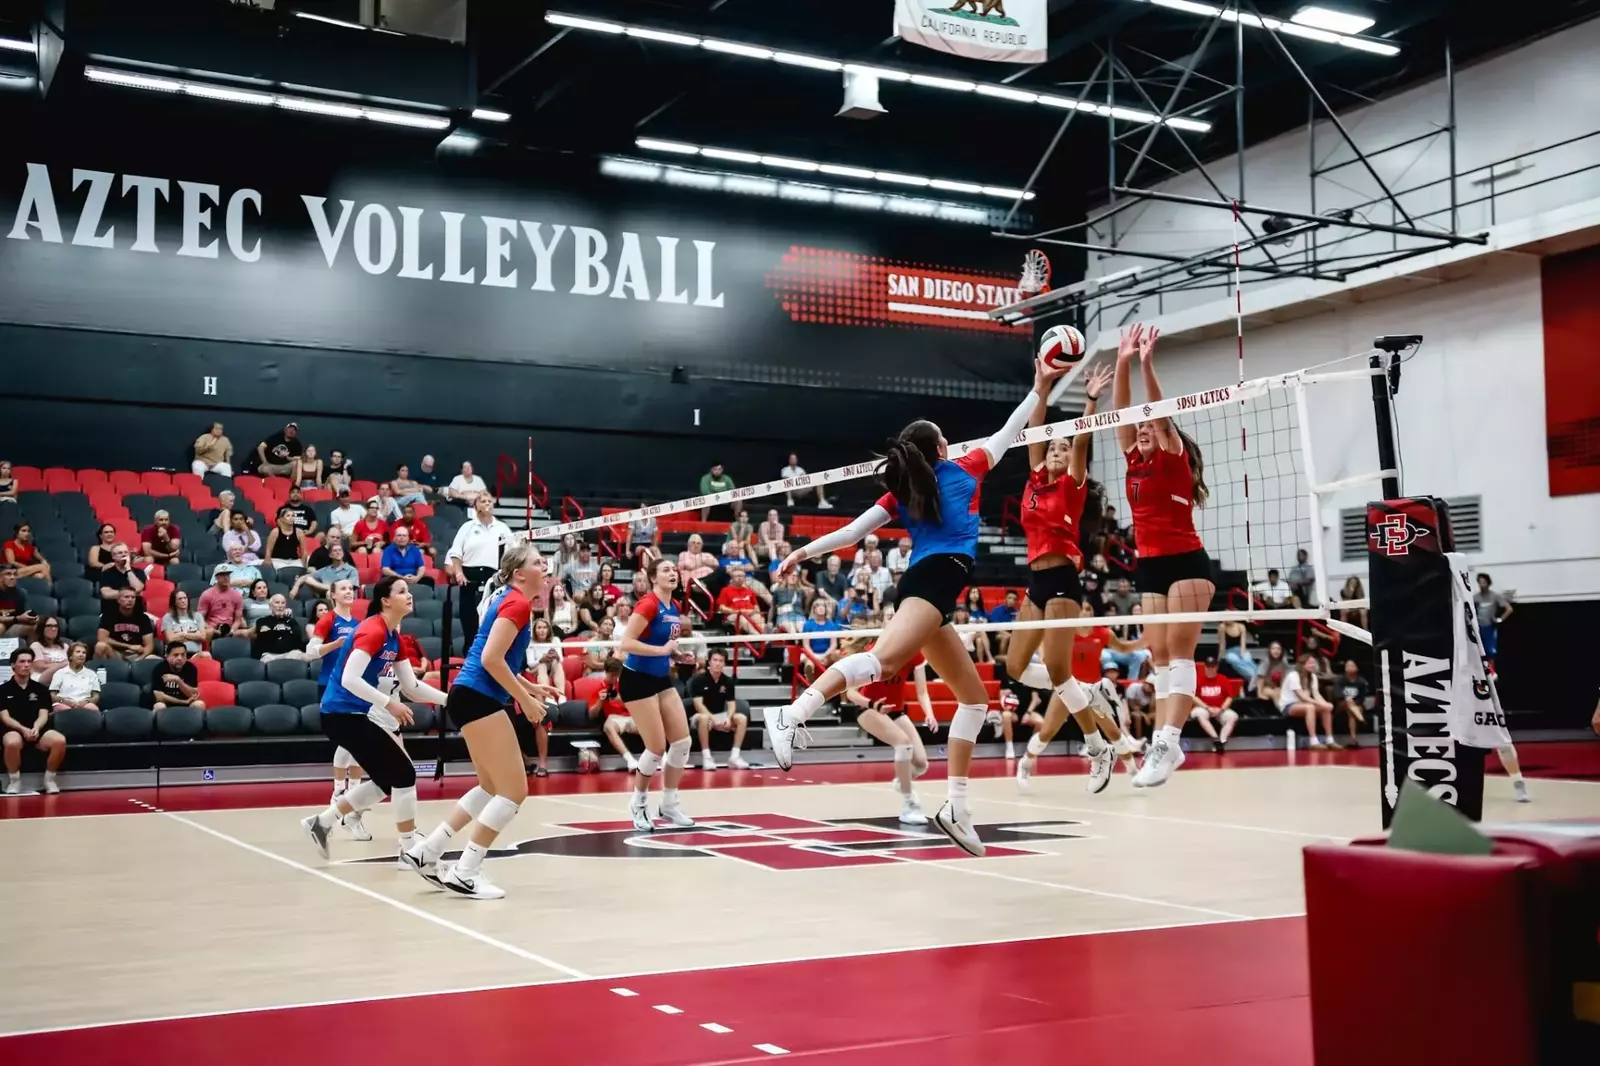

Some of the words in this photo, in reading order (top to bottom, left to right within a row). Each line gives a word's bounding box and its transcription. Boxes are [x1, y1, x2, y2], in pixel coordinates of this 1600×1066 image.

[921, 14, 977, 38] CALIFORNIA
[983, 29, 1027, 46] REPUBLIC
[7, 162, 262, 263] AZTEC
[301, 194, 725, 308] VOLLEYBALL
[888, 273, 920, 298] SAN
[923, 277, 975, 304] DIEGO
[976, 283, 1023, 307] STATE
[203, 376, 218, 395] H
[1176, 394, 1197, 411] SDSU
[1200, 387, 1230, 406] AZTECS
[1074, 417, 1092, 431] SDSU
[1094, 410, 1121, 428] AZTECS
[1029, 492, 1039, 511] 5
[1131, 481, 1140, 503] 7
